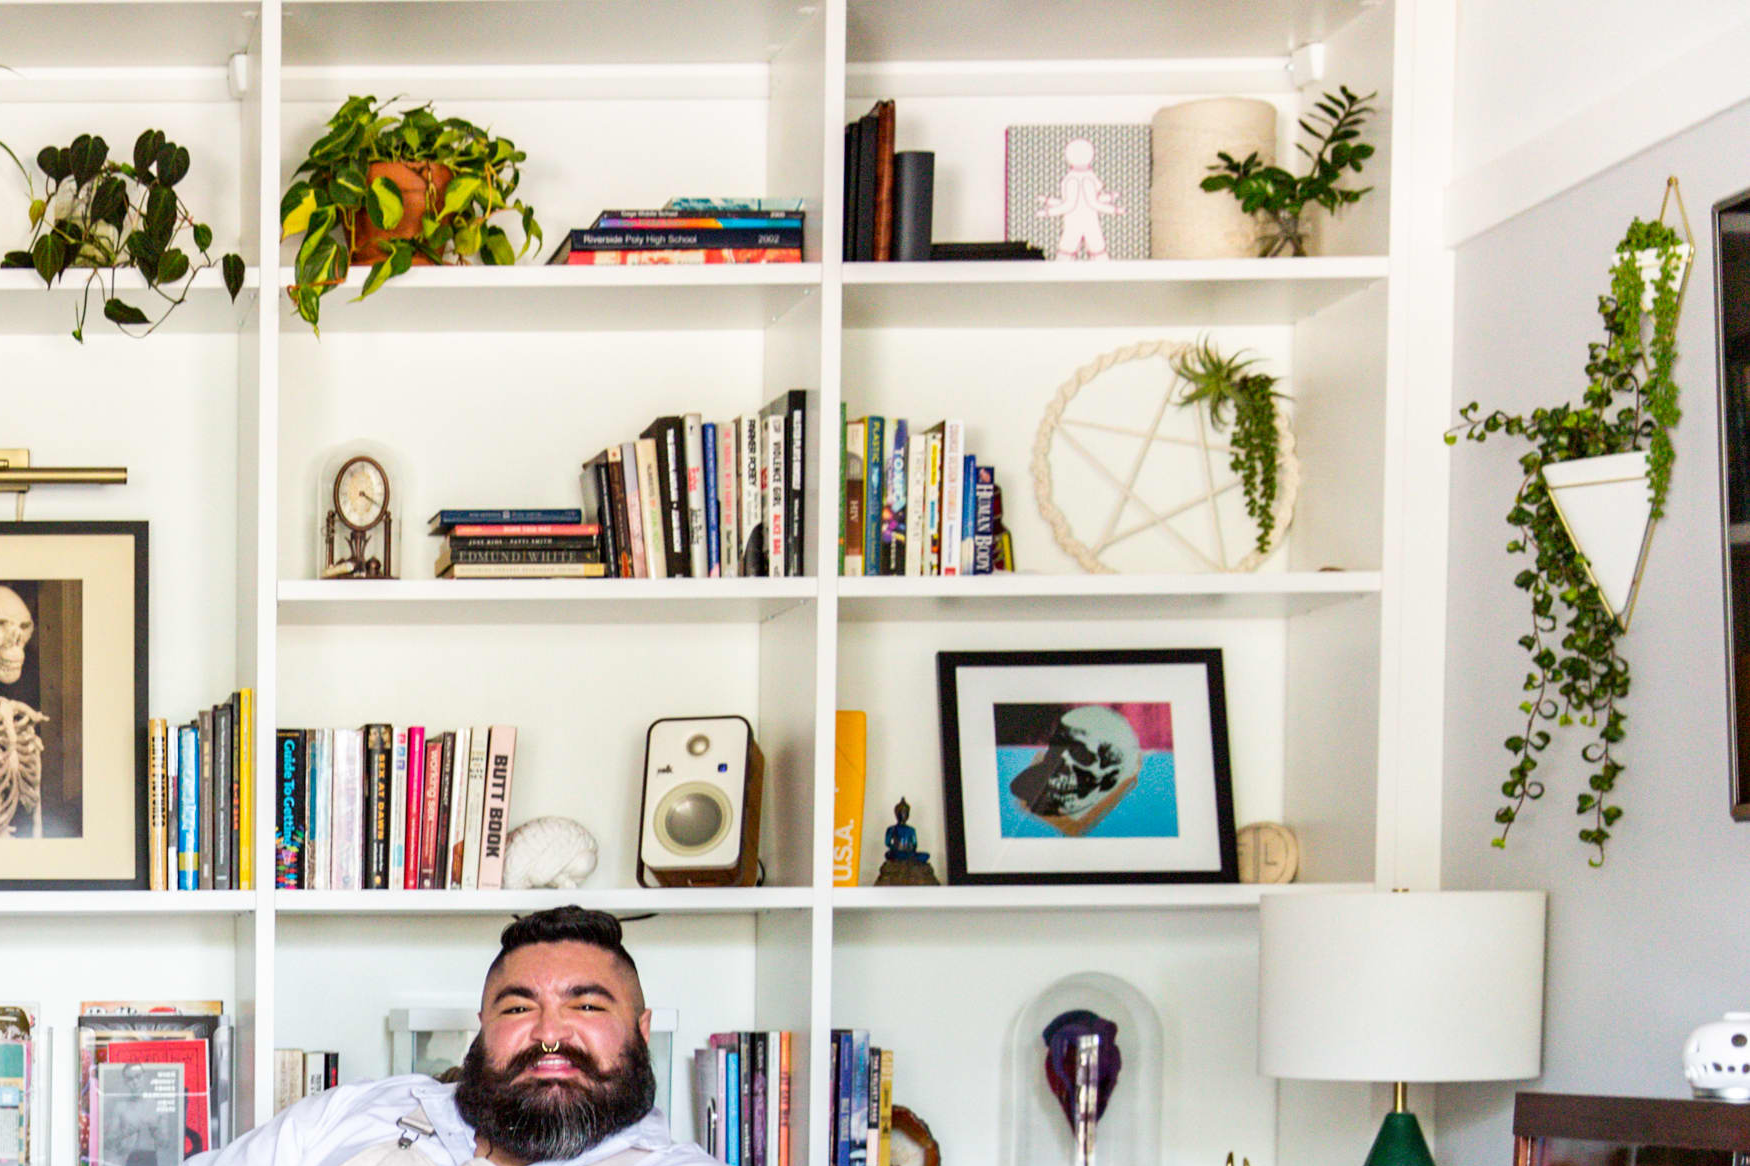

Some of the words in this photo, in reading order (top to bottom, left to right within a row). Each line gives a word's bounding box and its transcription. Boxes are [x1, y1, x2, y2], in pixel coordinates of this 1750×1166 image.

[583, 234, 623, 244] Riverside
[624, 234, 644, 247] Poly
[646, 234, 666, 246] High
[668, 234, 697, 244] School
[758, 234, 780, 244] 2002
[747, 419, 757, 456] PARKER
[872, 422, 881, 464] PLASTIC
[747, 456, 757, 488] POSEY
[772, 441, 782, 483] VIOLENCE
[772, 486, 781, 507] GIRL
[849, 499, 858, 523] HIV
[976, 484, 994, 532] HUMAN
[773, 513, 782, 535] ALICE
[458, 551, 521, 563] EDMUND
[528, 551, 577, 563] WHITE
[773, 538, 781, 556] BAG
[975, 535, 994, 573] BODY
[283, 739, 296, 779] Guide
[377, 753, 386, 780] SEX
[426, 748, 440, 799] working
[283, 779, 295, 797] To
[377, 781, 386, 799] AT
[491, 754, 509, 803] BUTT
[282, 797, 296, 847] Getting
[377, 801, 386, 841] DAWN
[426, 799, 437, 823] sex
[485, 806, 504, 859] BOOK
[834, 818, 855, 882] U.S.A.
